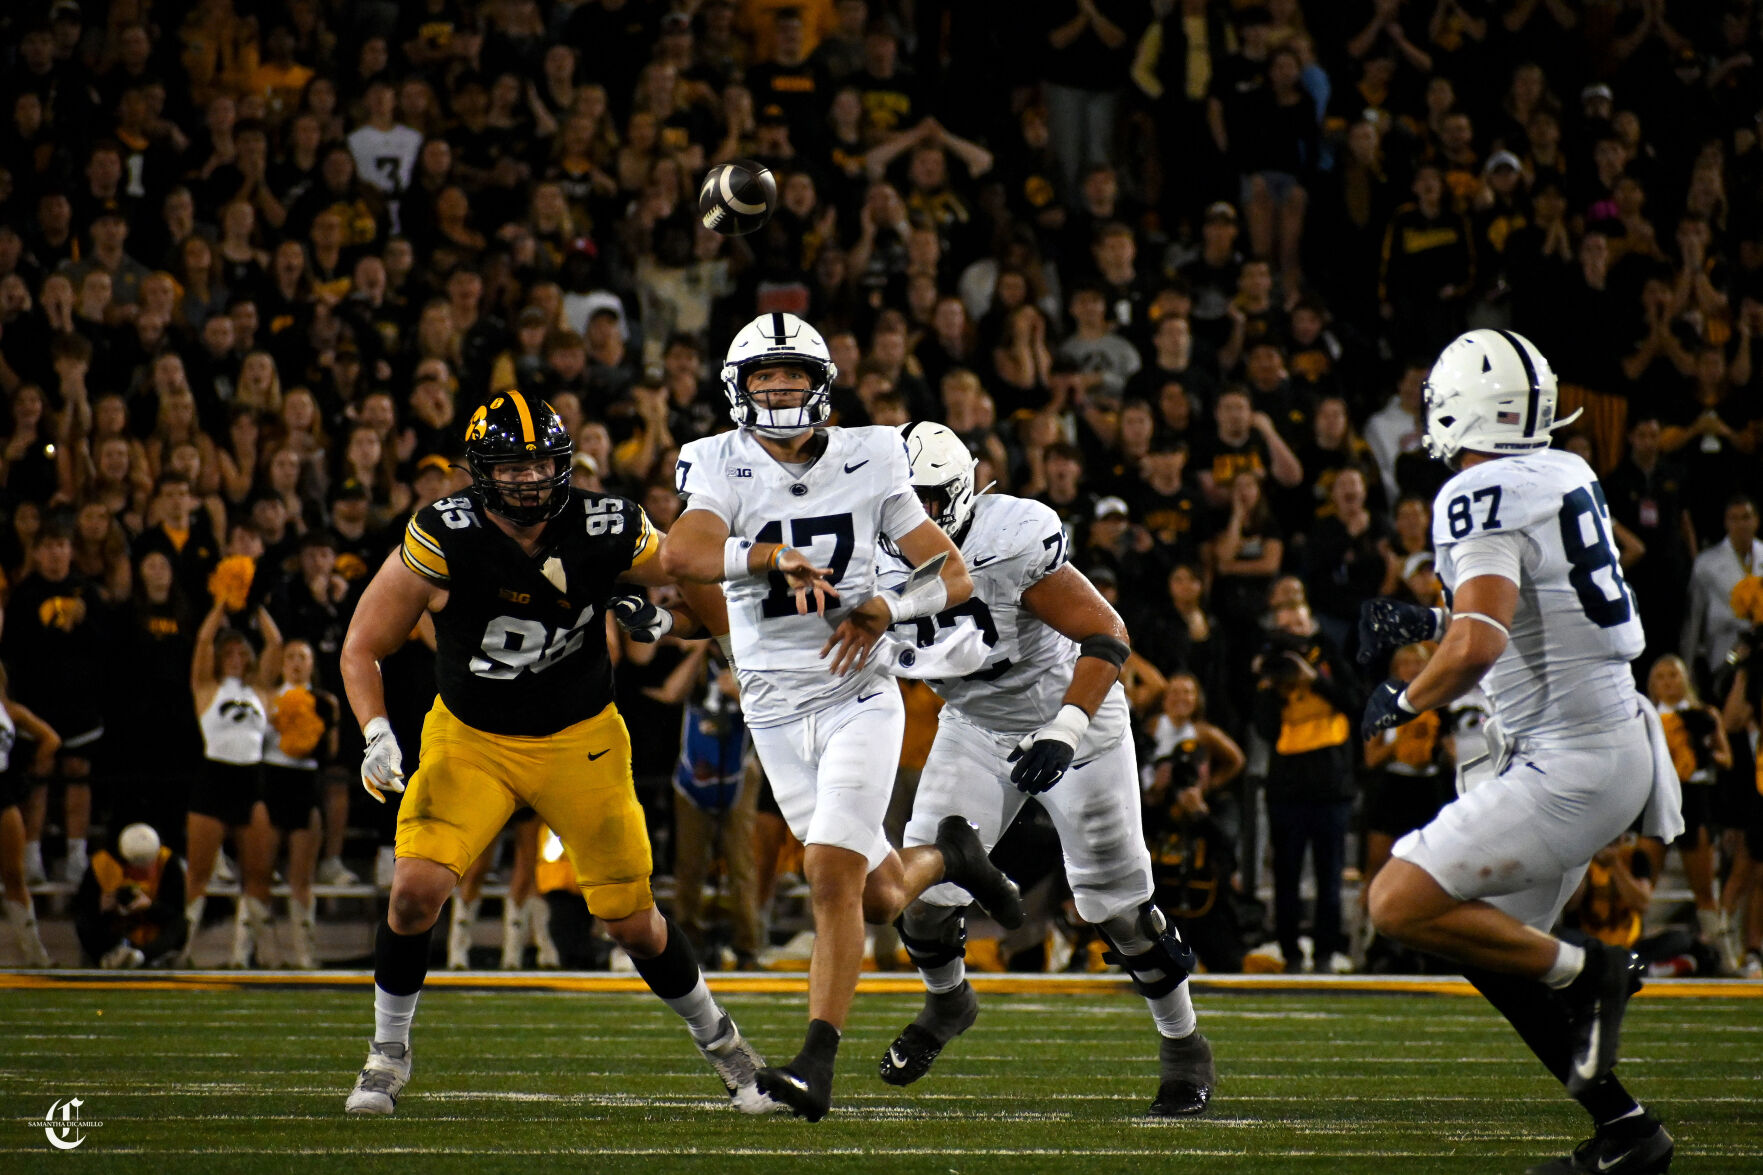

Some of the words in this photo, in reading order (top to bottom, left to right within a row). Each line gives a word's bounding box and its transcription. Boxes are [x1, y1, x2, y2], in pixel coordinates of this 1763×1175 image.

[432, 497, 482, 530] 95
[584, 498, 625, 536] 95
[1448, 485, 1502, 539] 87
[755, 512, 855, 618] 17
